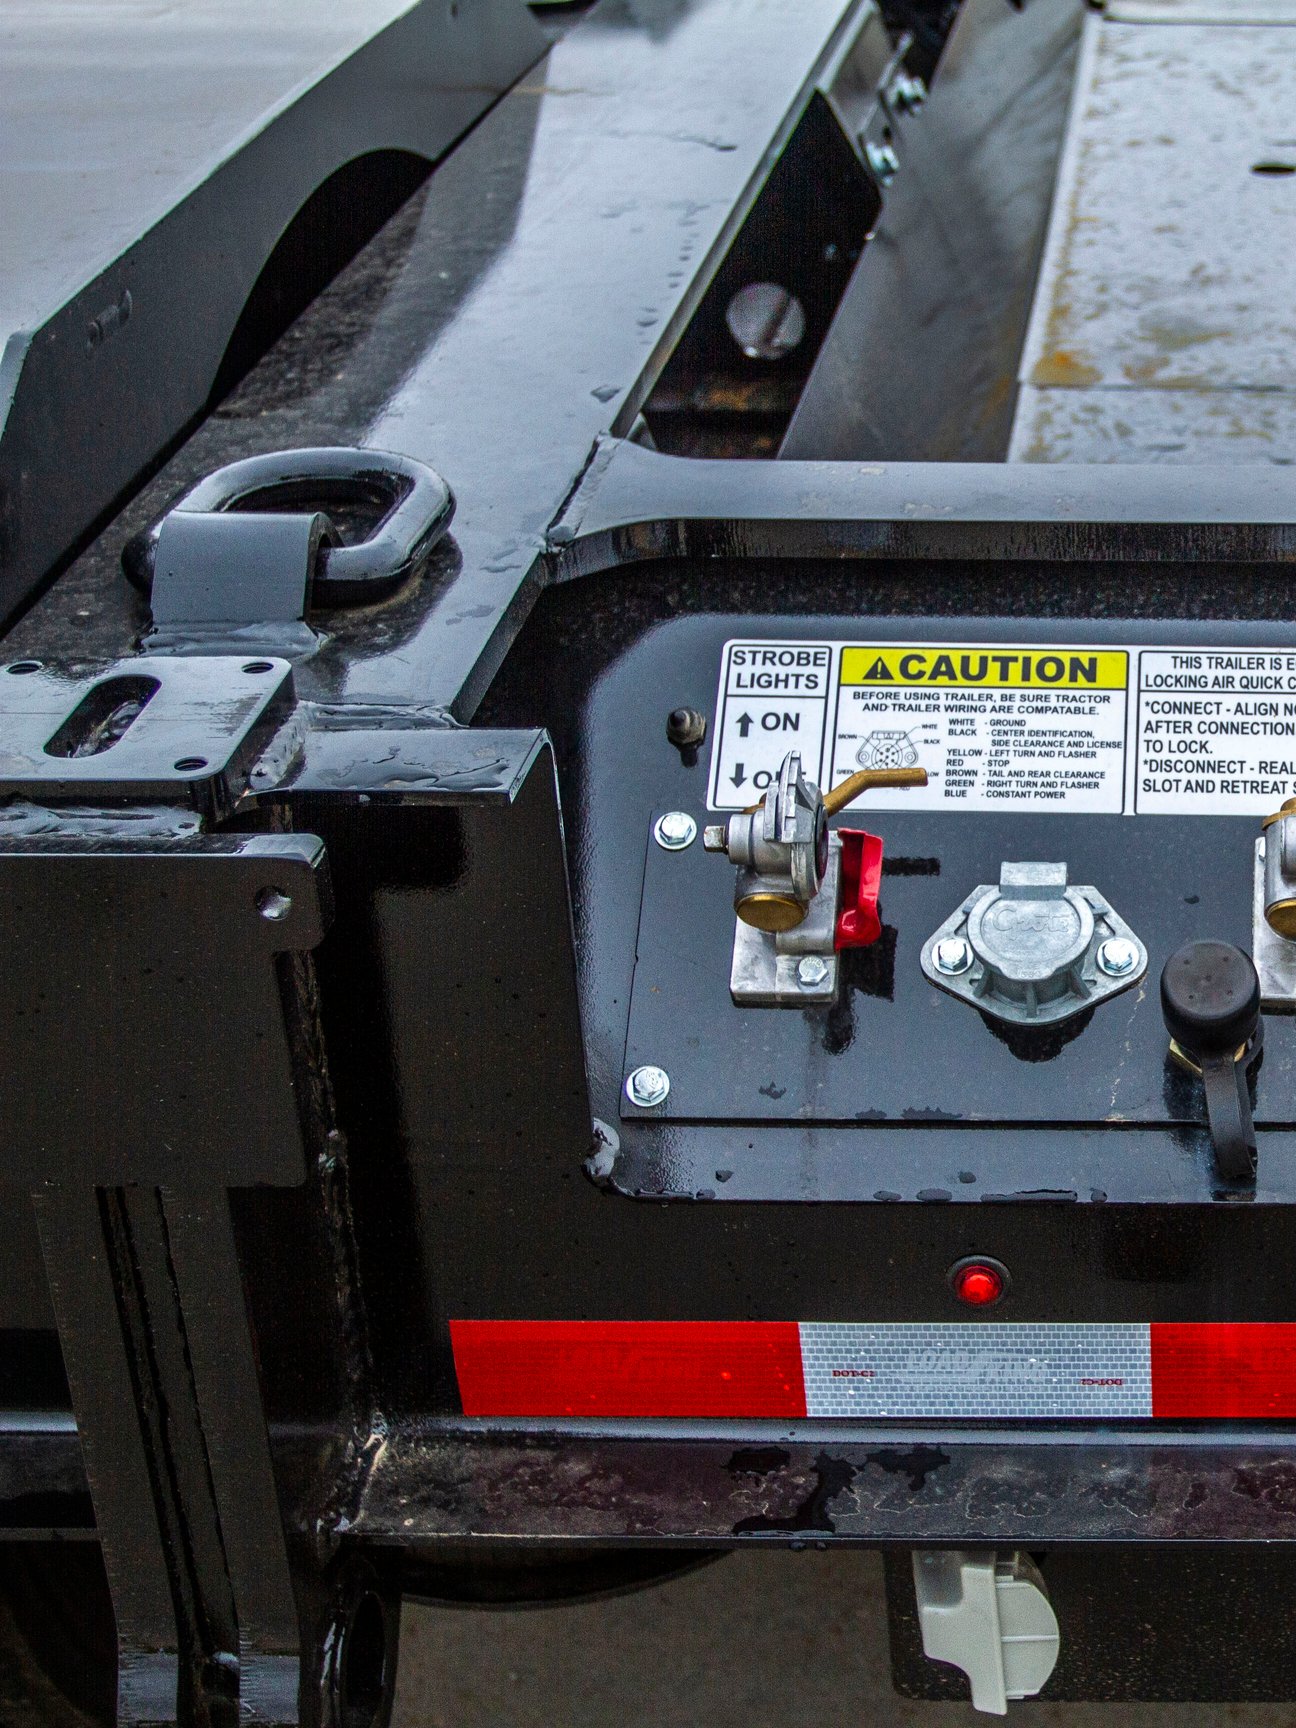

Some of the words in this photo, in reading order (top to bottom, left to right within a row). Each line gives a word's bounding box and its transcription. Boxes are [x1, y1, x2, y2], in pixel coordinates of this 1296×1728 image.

[732, 650, 826, 666] STROBE
[1171, 656, 1202, 669] THIS
[1207, 656, 1265, 670] TRAILER
[1270, 657, 1282, 670] IS
[898, 654, 1098, 683] CAUTION
[736, 673, 818, 690] LIGHTS
[1145, 674, 1208, 689] LOCKING
[1212, 675, 1236, 689] AIR
[1240, 676, 1284, 691] QUICK
[853, 691, 900, 700] BEFORE
[905, 692, 940, 701] USING
[944, 693, 996, 703] TRAILER,
[1001, 694, 1015, 702] BE
[1020, 694, 1051, 703] SURE
[1055, 694, 1110, 704] TRACTOR
[863, 703, 888, 712] AND
[892, 703, 940, 712] TRAILER
[944, 705, 986, 713] WIRING
[990, 705, 1013, 714] ARE
[1018, 706, 1099, 715] COMPATABLE.
[1234, 702, 1278, 717] ALIGN
[762, 712, 800, 731] ON
[1144, 720, 1192, 734] AFTER
[1028, 730, 1094, 739] IDENTIFICATION,
[1087, 741, 1123, 749] LICENSE
[1144, 740, 1163, 753] TO
[1169, 740, 1212, 754] LOCK.
[947, 749, 982, 757] YELLOW
[1054, 771, 1105, 779] CLEARANCE
[1061, 781, 1099, 789] FLASHER
[1143, 779, 1182, 793] SLOT
[1184, 780, 1215, 793] AND
[1221, 780, 1288, 794] RETREAT
[986, 790, 1032, 798] CONSTANT
